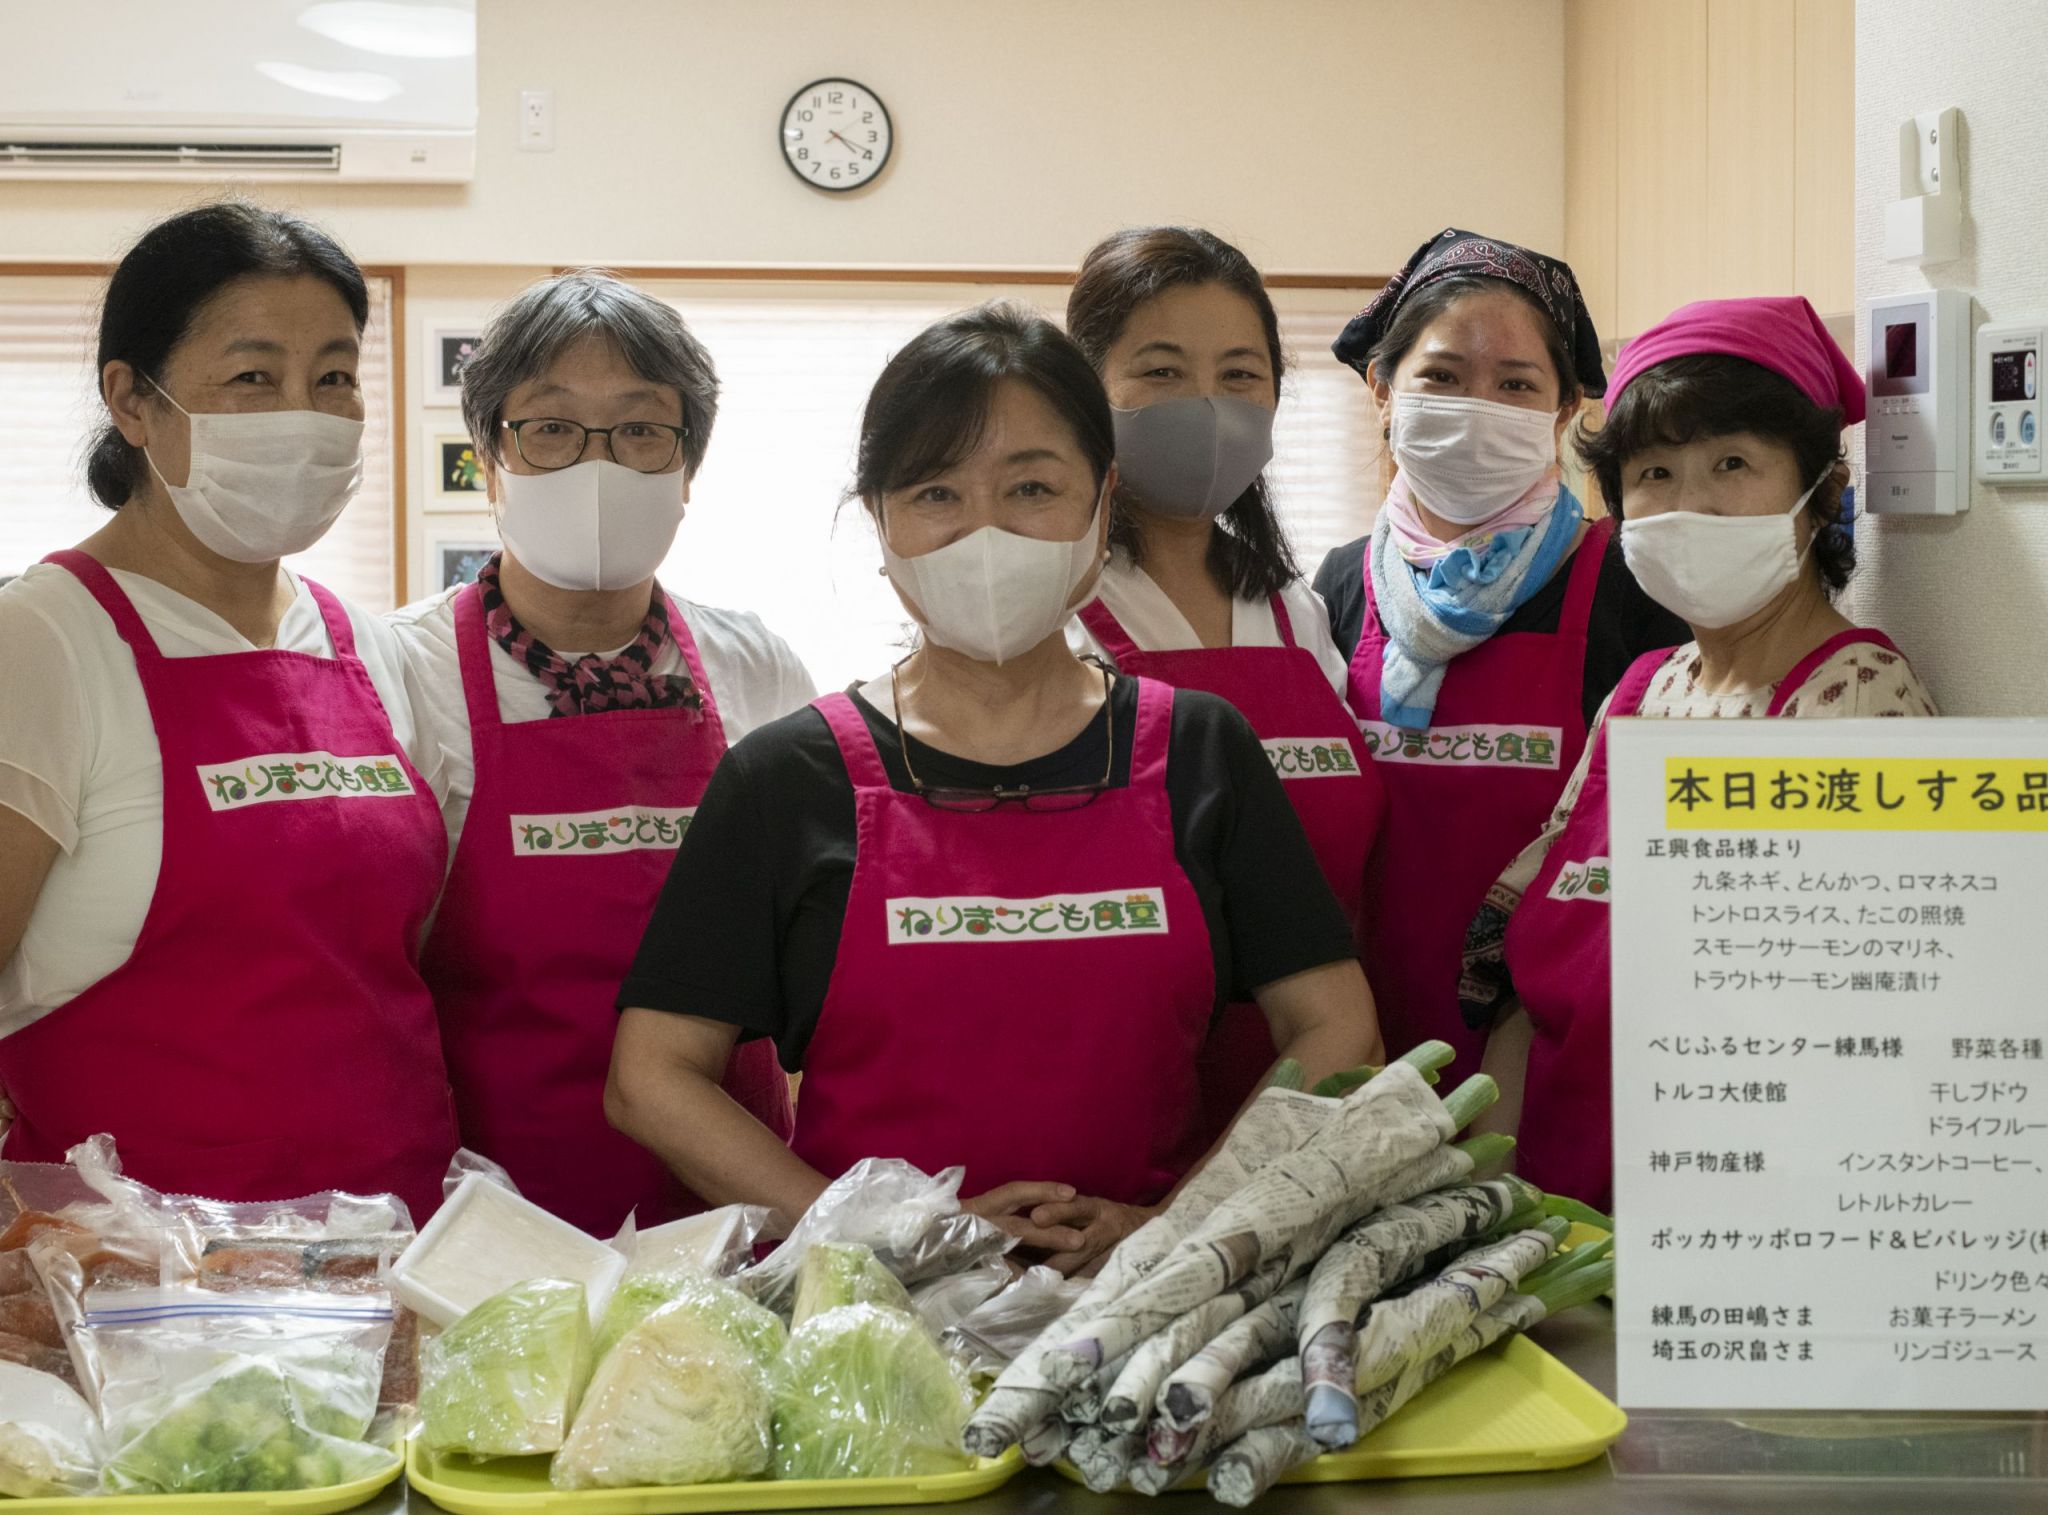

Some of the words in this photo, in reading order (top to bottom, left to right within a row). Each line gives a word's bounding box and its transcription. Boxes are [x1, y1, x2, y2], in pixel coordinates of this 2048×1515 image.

[812, 96, 822, 109] 11
[828, 91, 844, 105] 12
[797, 109, 813, 122] 10
[861, 111, 873, 124] 2
[867, 130, 878, 142] 3
[797, 147, 809, 160] 8
[861, 149, 873, 161] 4
[811, 161, 822, 174] 7
[829, 167, 841, 180] 6
[848, 162, 859, 175] 5
[207, 761, 410, 804] ねりまこども食堂
[1667, 767, 2048, 814] 本日お渡しする品
[1645, 837, 1801, 860] 正興食品様より
[1692, 870, 1998, 893] 九条ネギ、とんかつ、ロマネスコ
[896, 893, 1160, 937] ねりまこども食堂
[1693, 904, 1966, 927] トントロスライス、たこの照焼
[1693, 937, 1954, 959] スモークサーモンのマリネ、
[1694, 969, 1941, 992] トラウトサーモン幽庵漬け
[1648, 1035, 1904, 1059] べじふるセンター練馬様
[1951, 1037, 2043, 1060] 野菜各種
[1654, 1080, 1788, 1104] トルコ大使館
[1930, 1081, 2028, 1103] 干しブドウ
[1929, 1115, 2048, 1138] ドライフルー
[1649, 1150, 1766, 1174] 神戸物産様
[1838, 1152, 2042, 1174] インスタントコーヒー、
[1838, 1192, 1973, 1213] レトルトカレー
[1651, 1304, 1813, 1328] 練馬の田嶋さま
[1889, 1305, 2037, 1328] お菓子ラーメン
[1894, 1339, 2037, 1363] リンゴジュース
